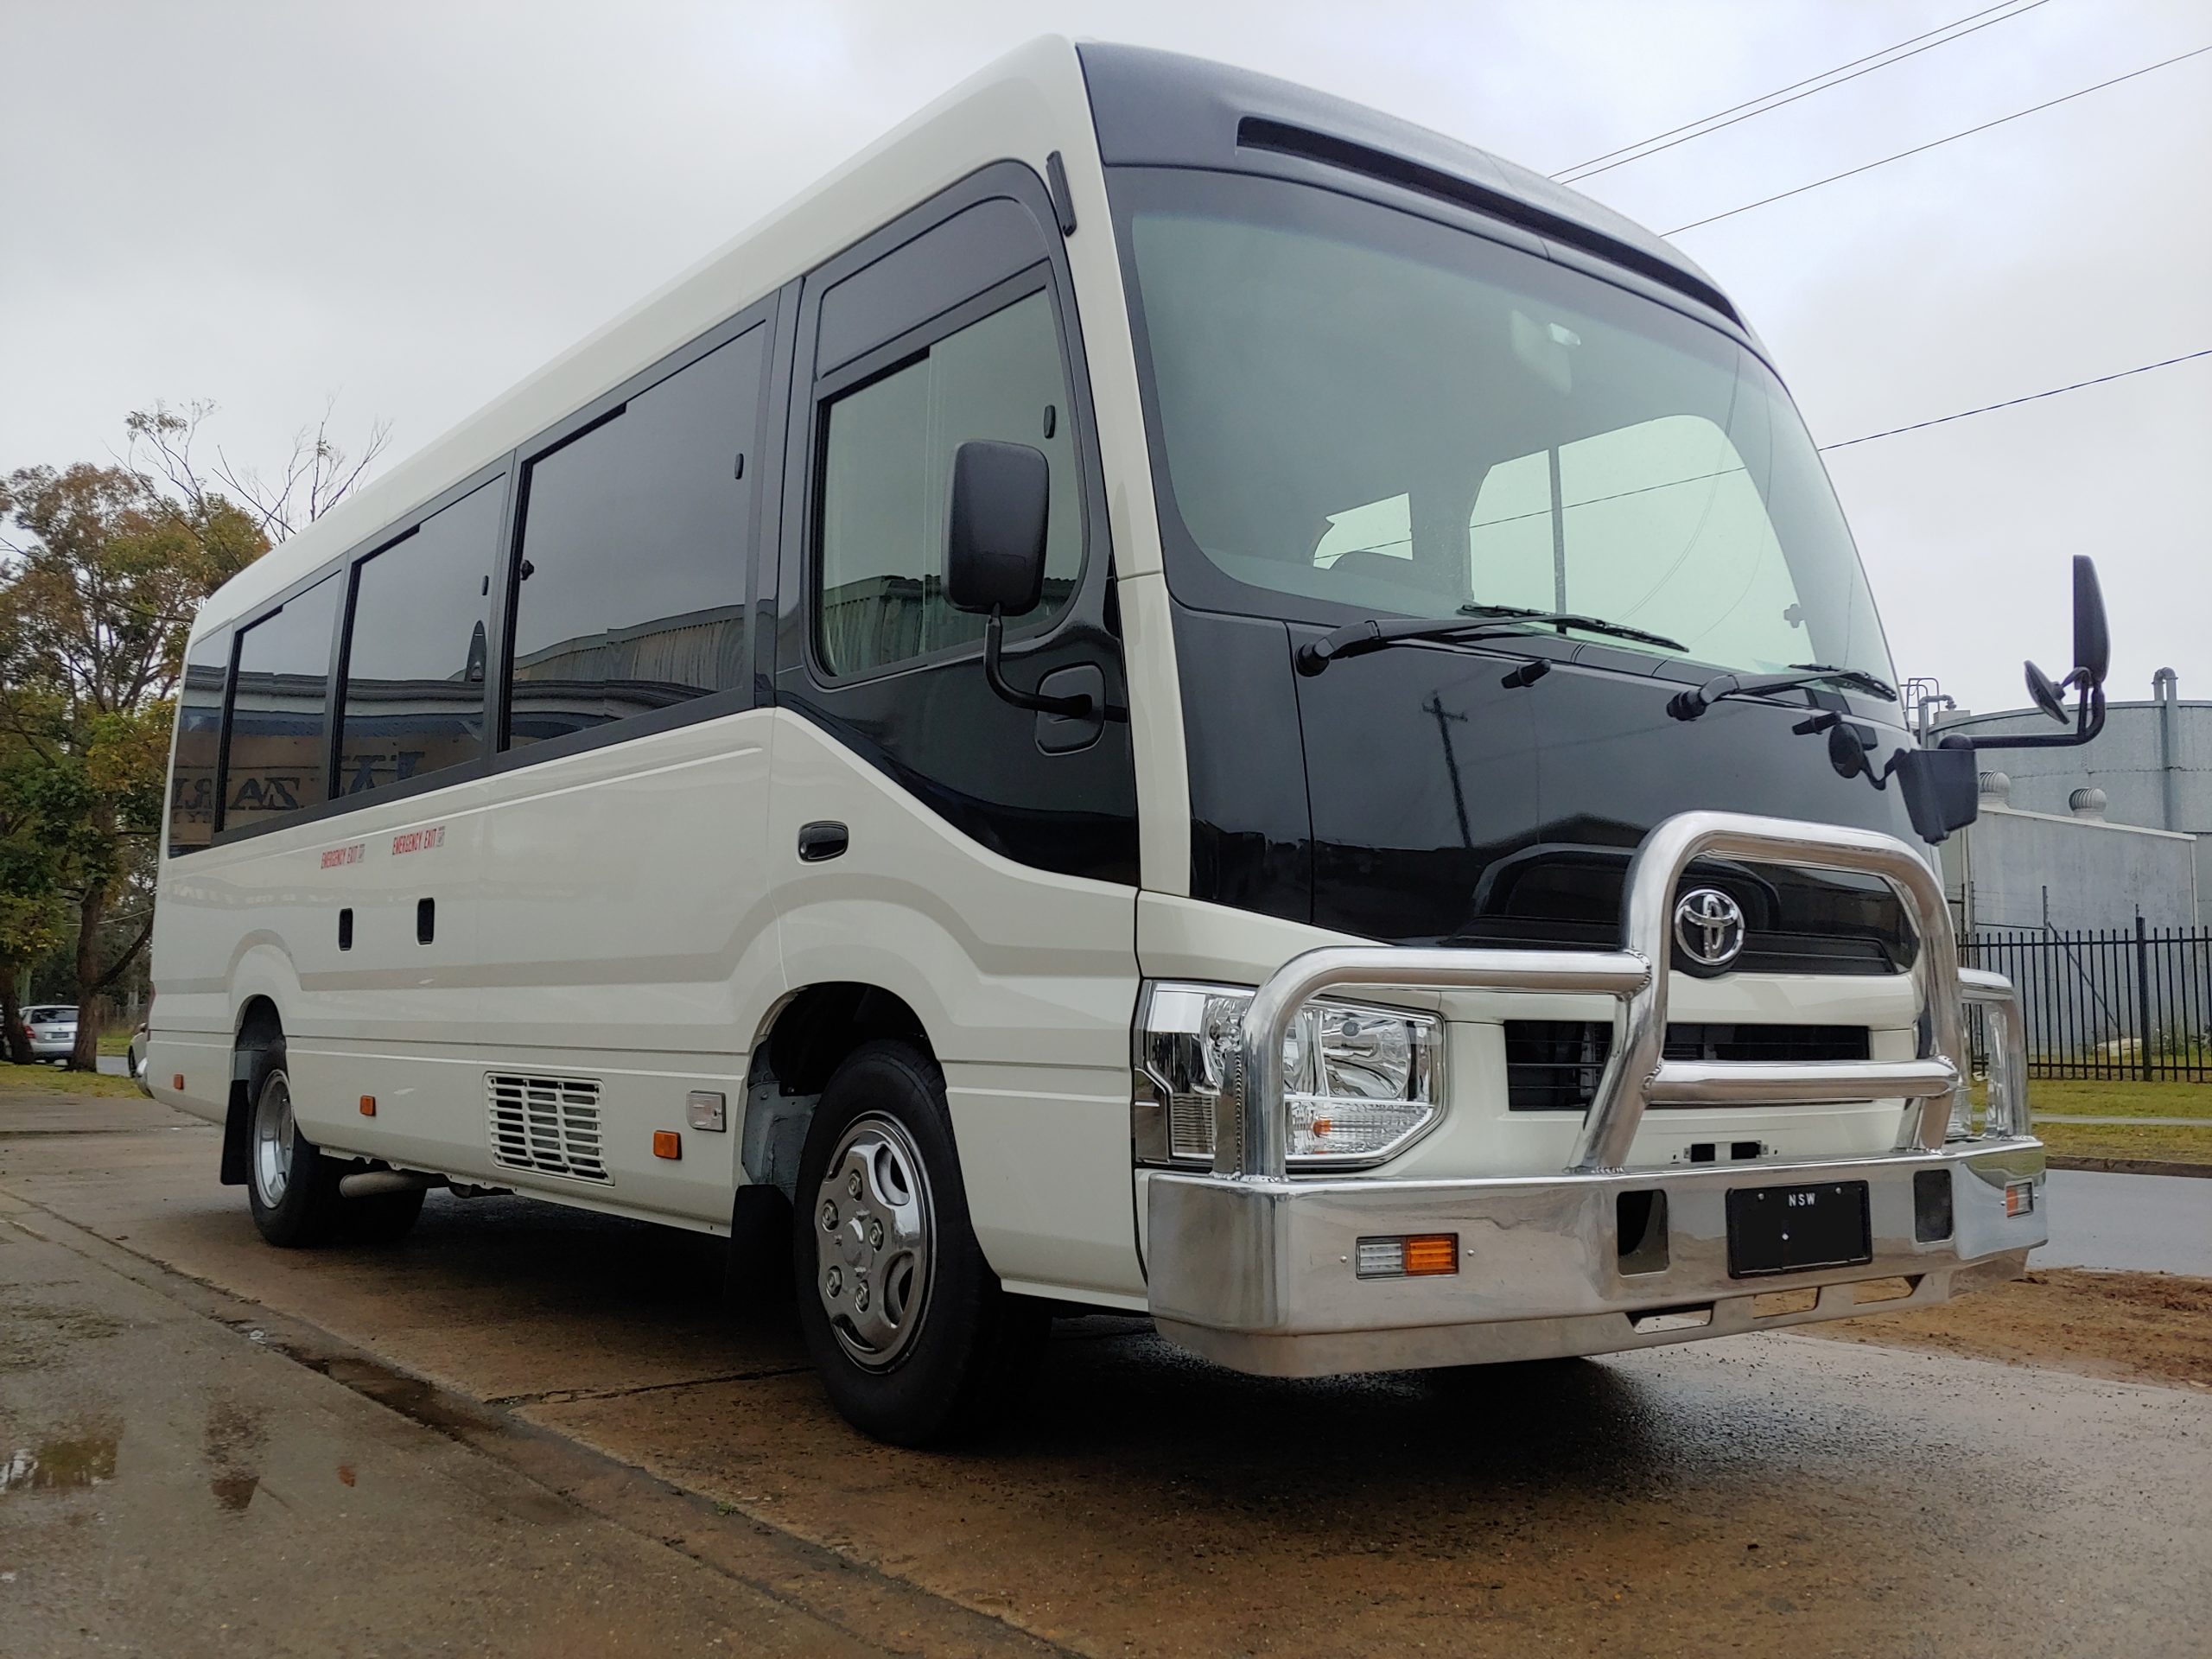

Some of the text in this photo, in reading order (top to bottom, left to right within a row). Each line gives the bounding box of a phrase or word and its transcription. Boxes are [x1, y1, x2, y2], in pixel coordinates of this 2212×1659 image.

[391, 829, 436, 855] EMERGENCY EXIT
[321, 845, 359, 869] EMERGENCY EXIT
[1789, 1192, 1815, 1207] NSW
